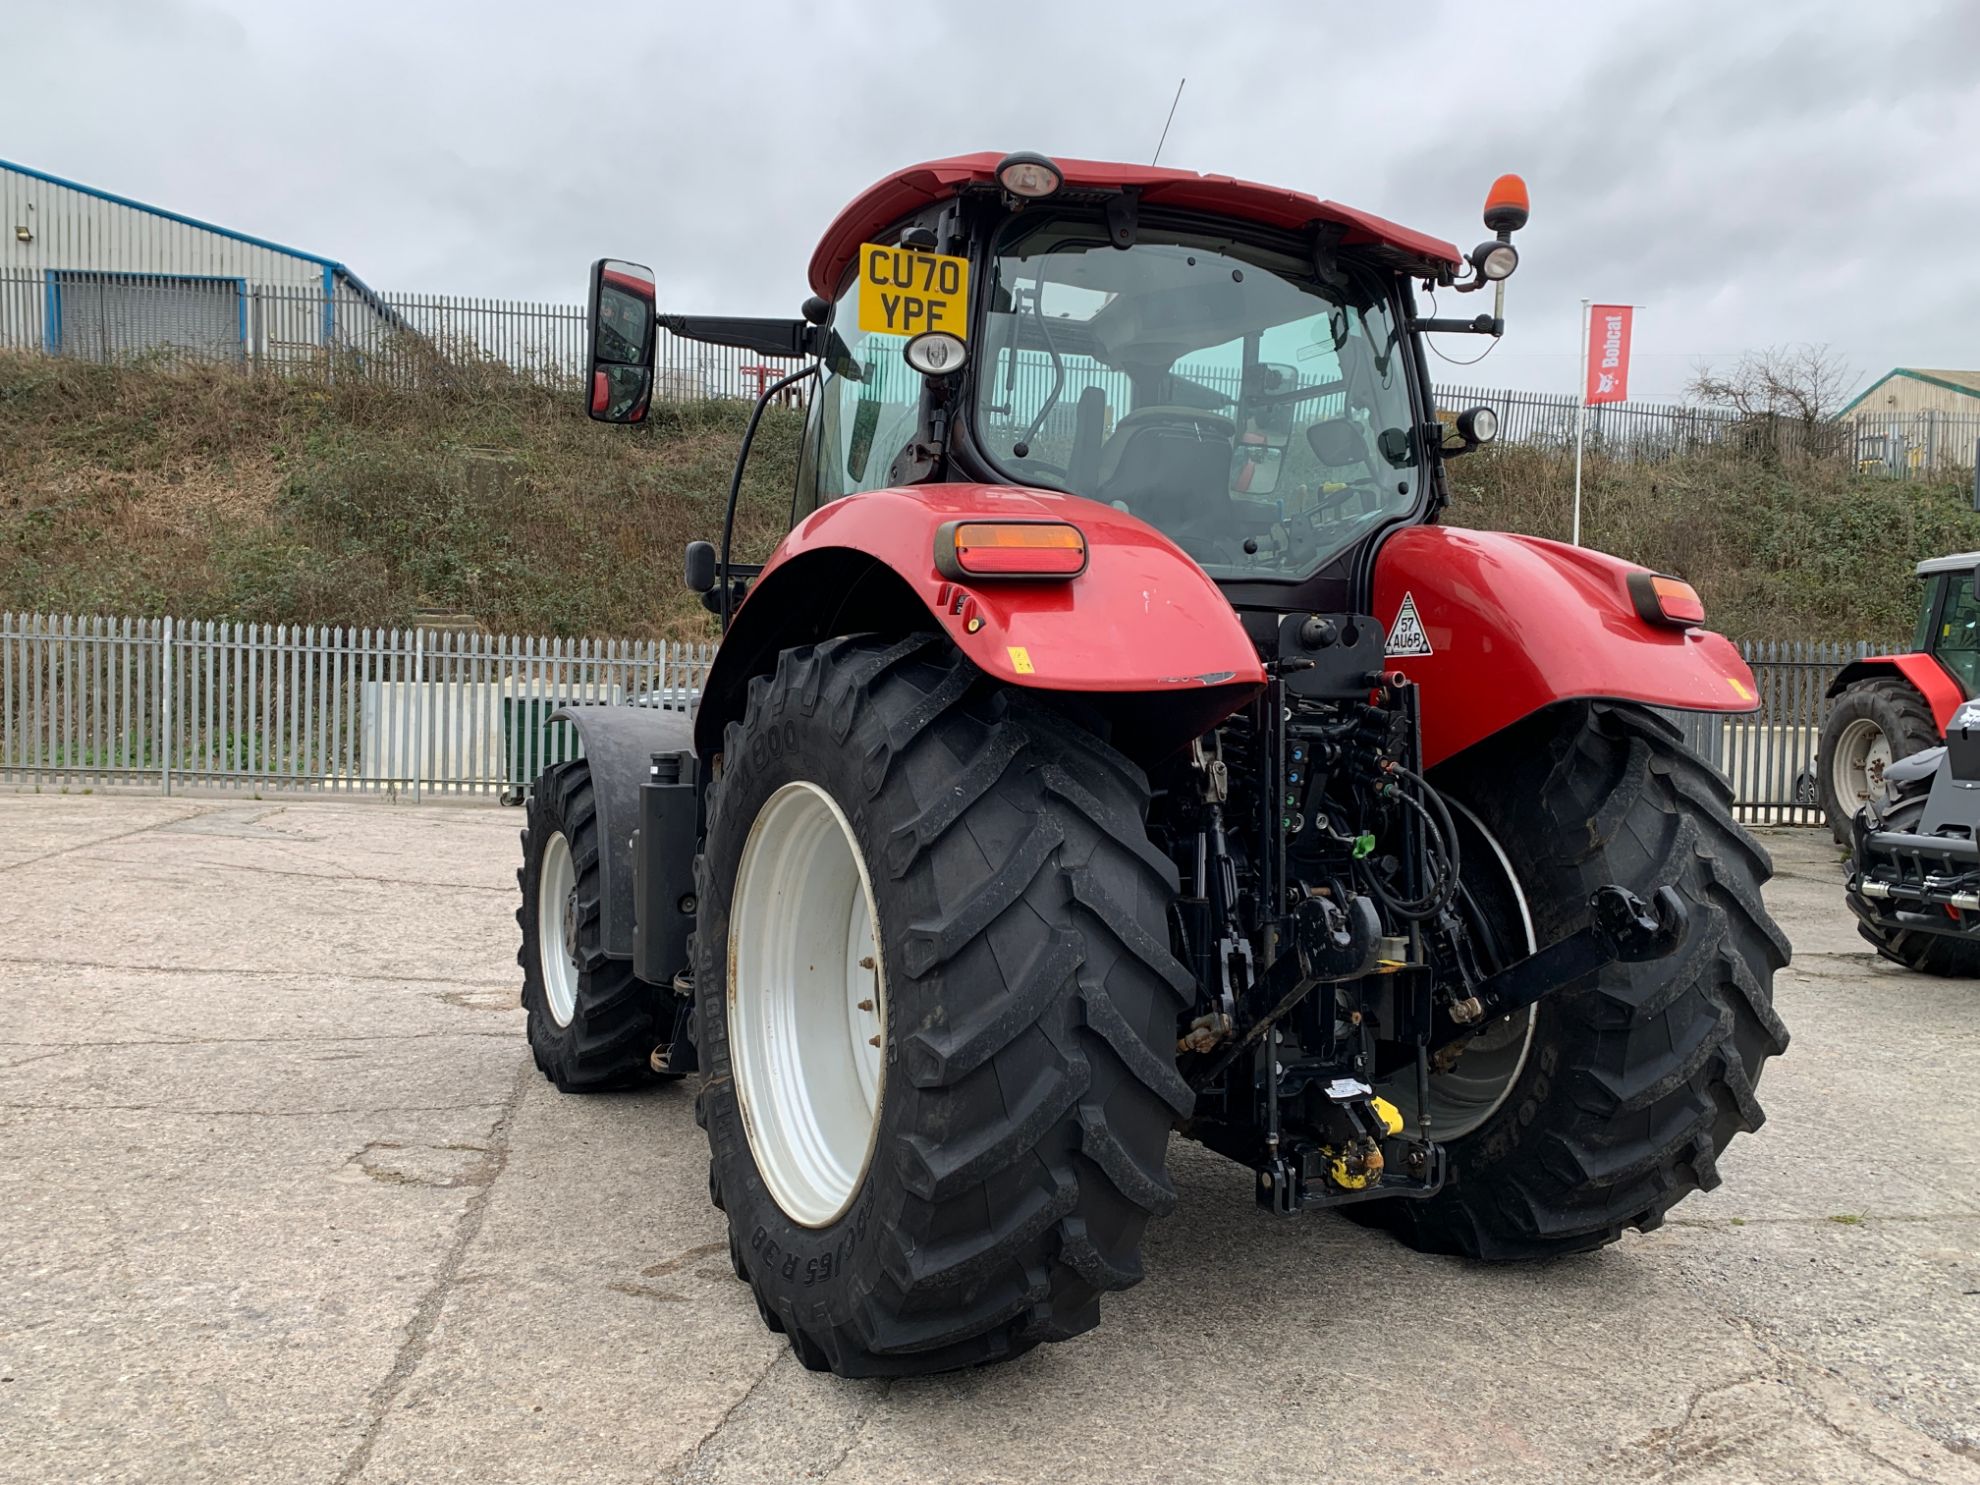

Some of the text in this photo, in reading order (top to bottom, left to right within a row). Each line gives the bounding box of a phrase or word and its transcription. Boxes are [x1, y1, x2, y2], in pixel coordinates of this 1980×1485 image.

[869, 250, 959, 295] CU70
[880, 293, 947, 333] YPF
[1602, 315, 1622, 368] Bobcat
[1401, 617, 1414, 633] 57
